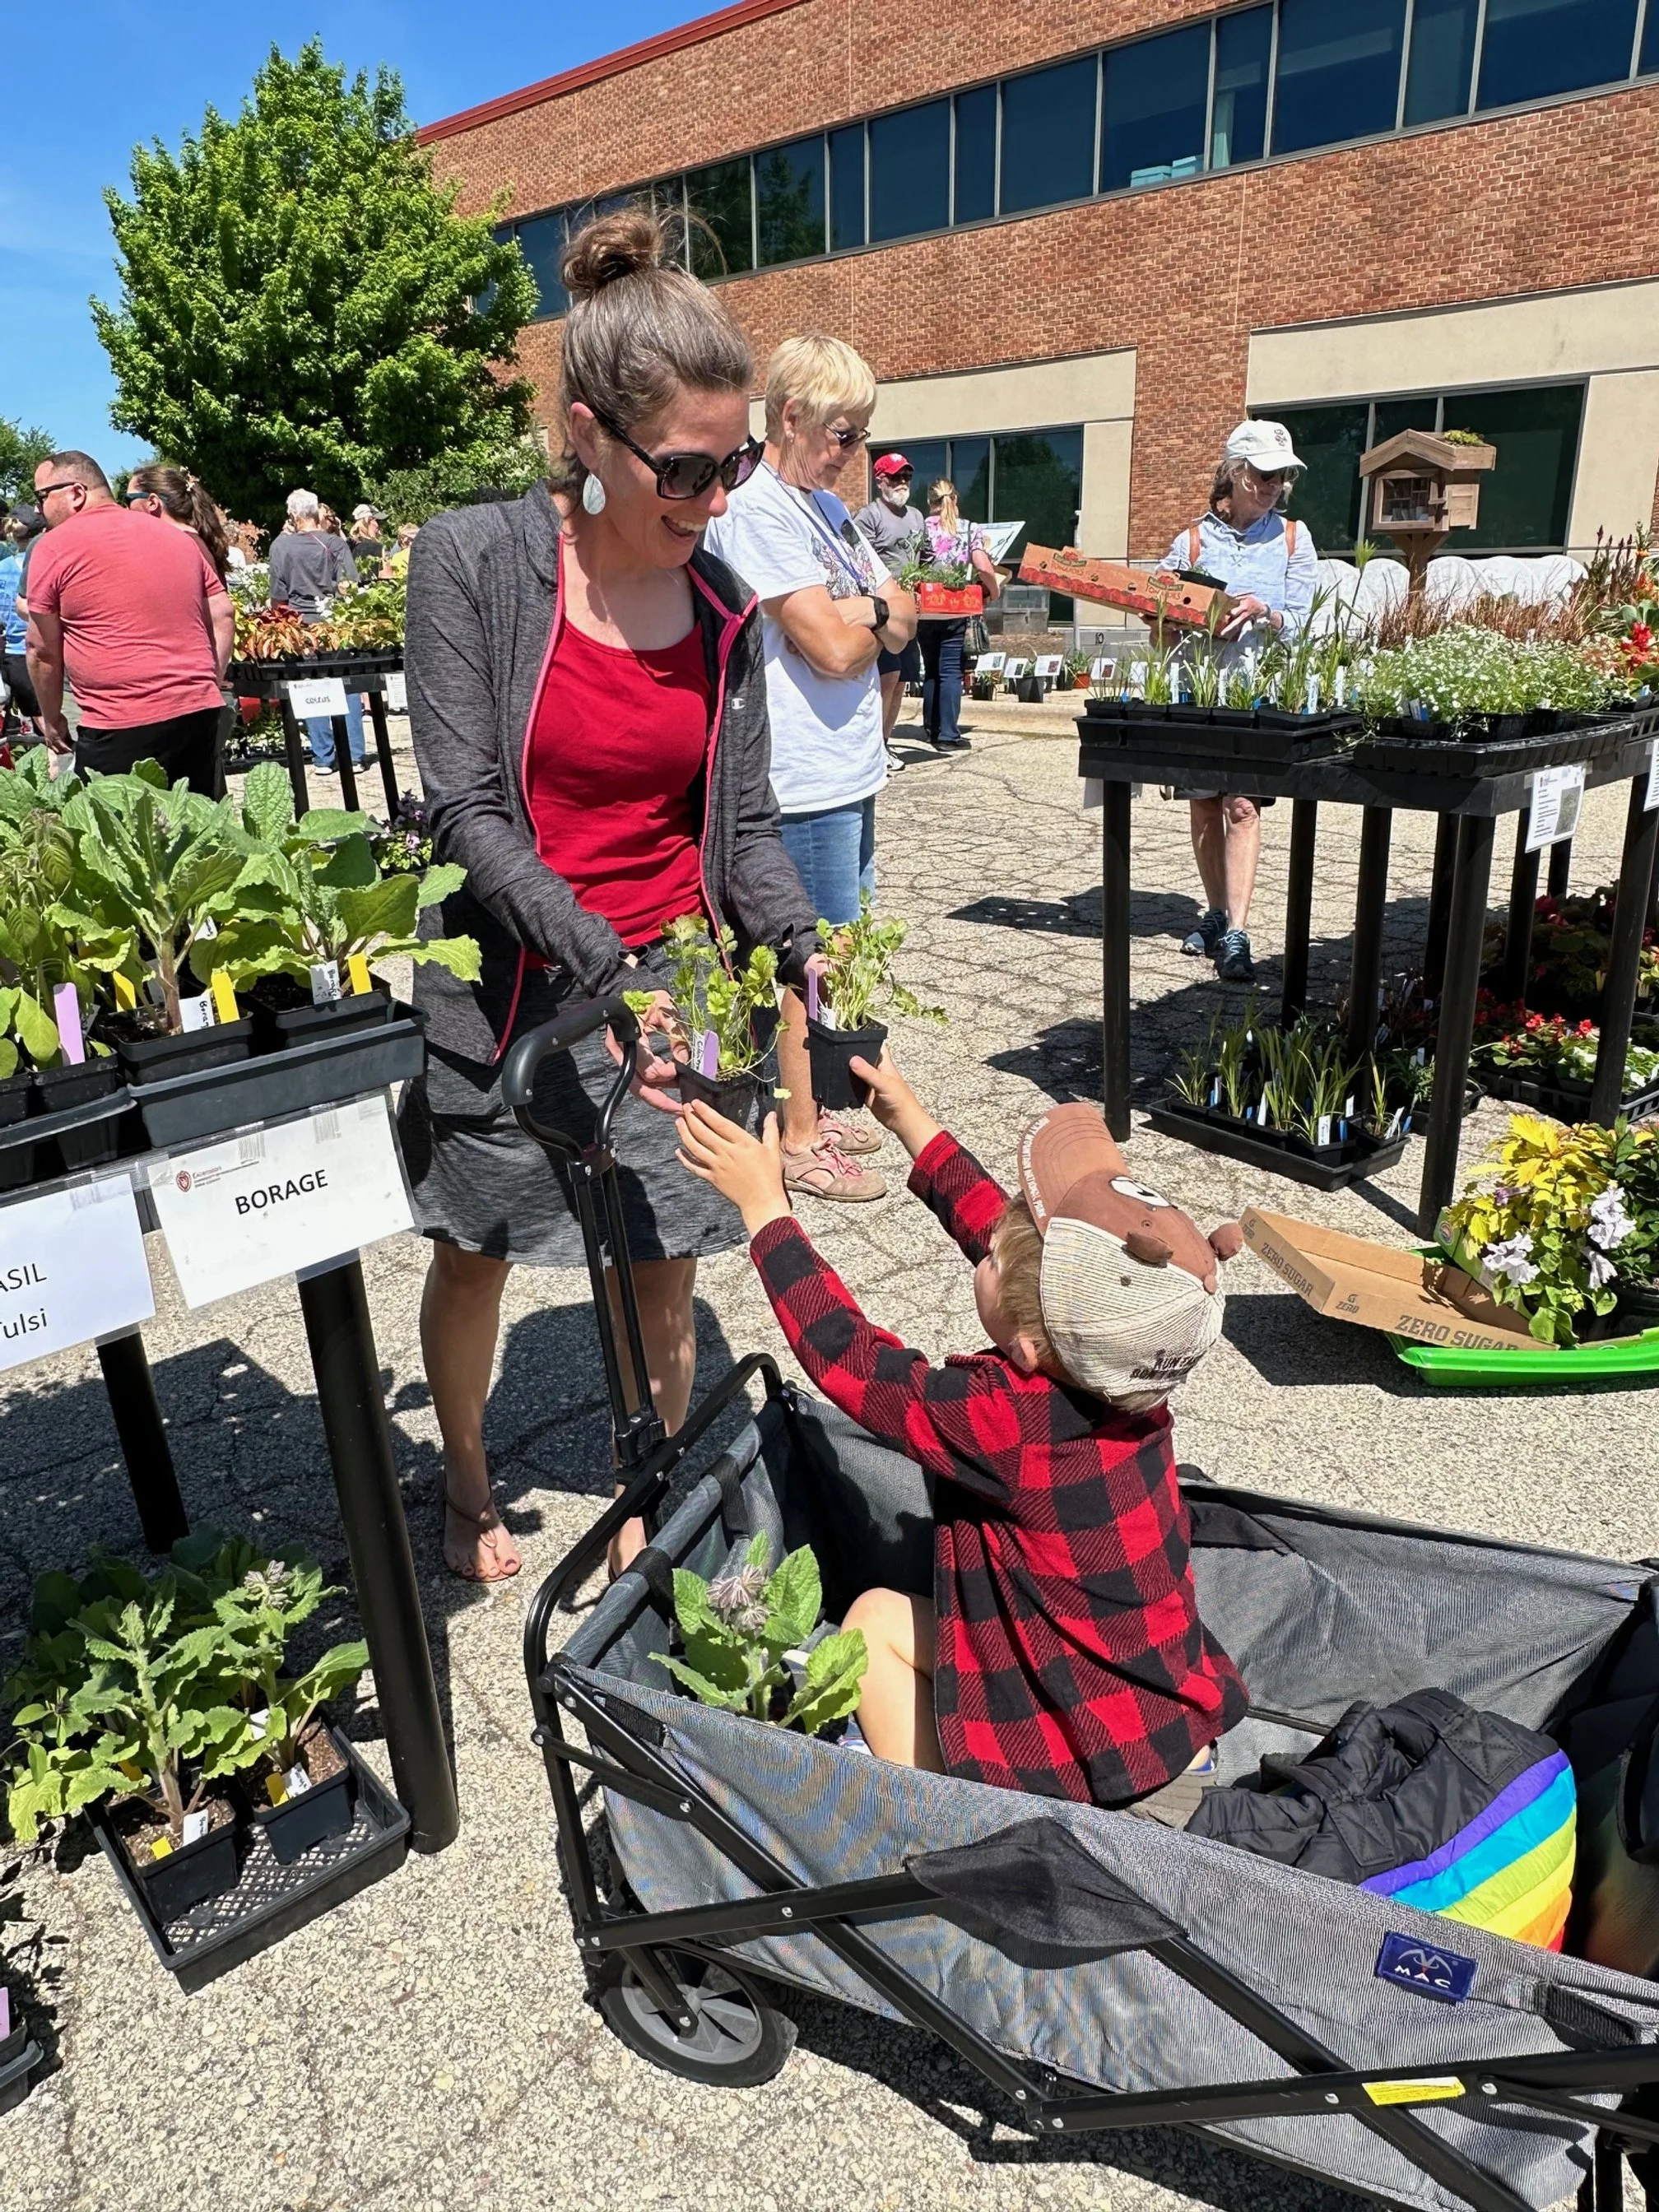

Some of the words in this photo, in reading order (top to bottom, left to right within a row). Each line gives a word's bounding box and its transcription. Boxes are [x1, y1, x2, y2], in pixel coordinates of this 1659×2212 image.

[235, 1169, 328, 1215] BORAGE
[1261, 1242, 1285, 1268] ZERO
[1284, 1262, 1313, 1297] SUGAR
[0, 1308, 47, 1339] ulsi
[1335, 1301, 1360, 1313] ZERO
[1395, 1315, 1451, 1341] ZERO
[1450, 1331, 1519, 1350] SUG
[1394, 1965, 1452, 1989] MAC
